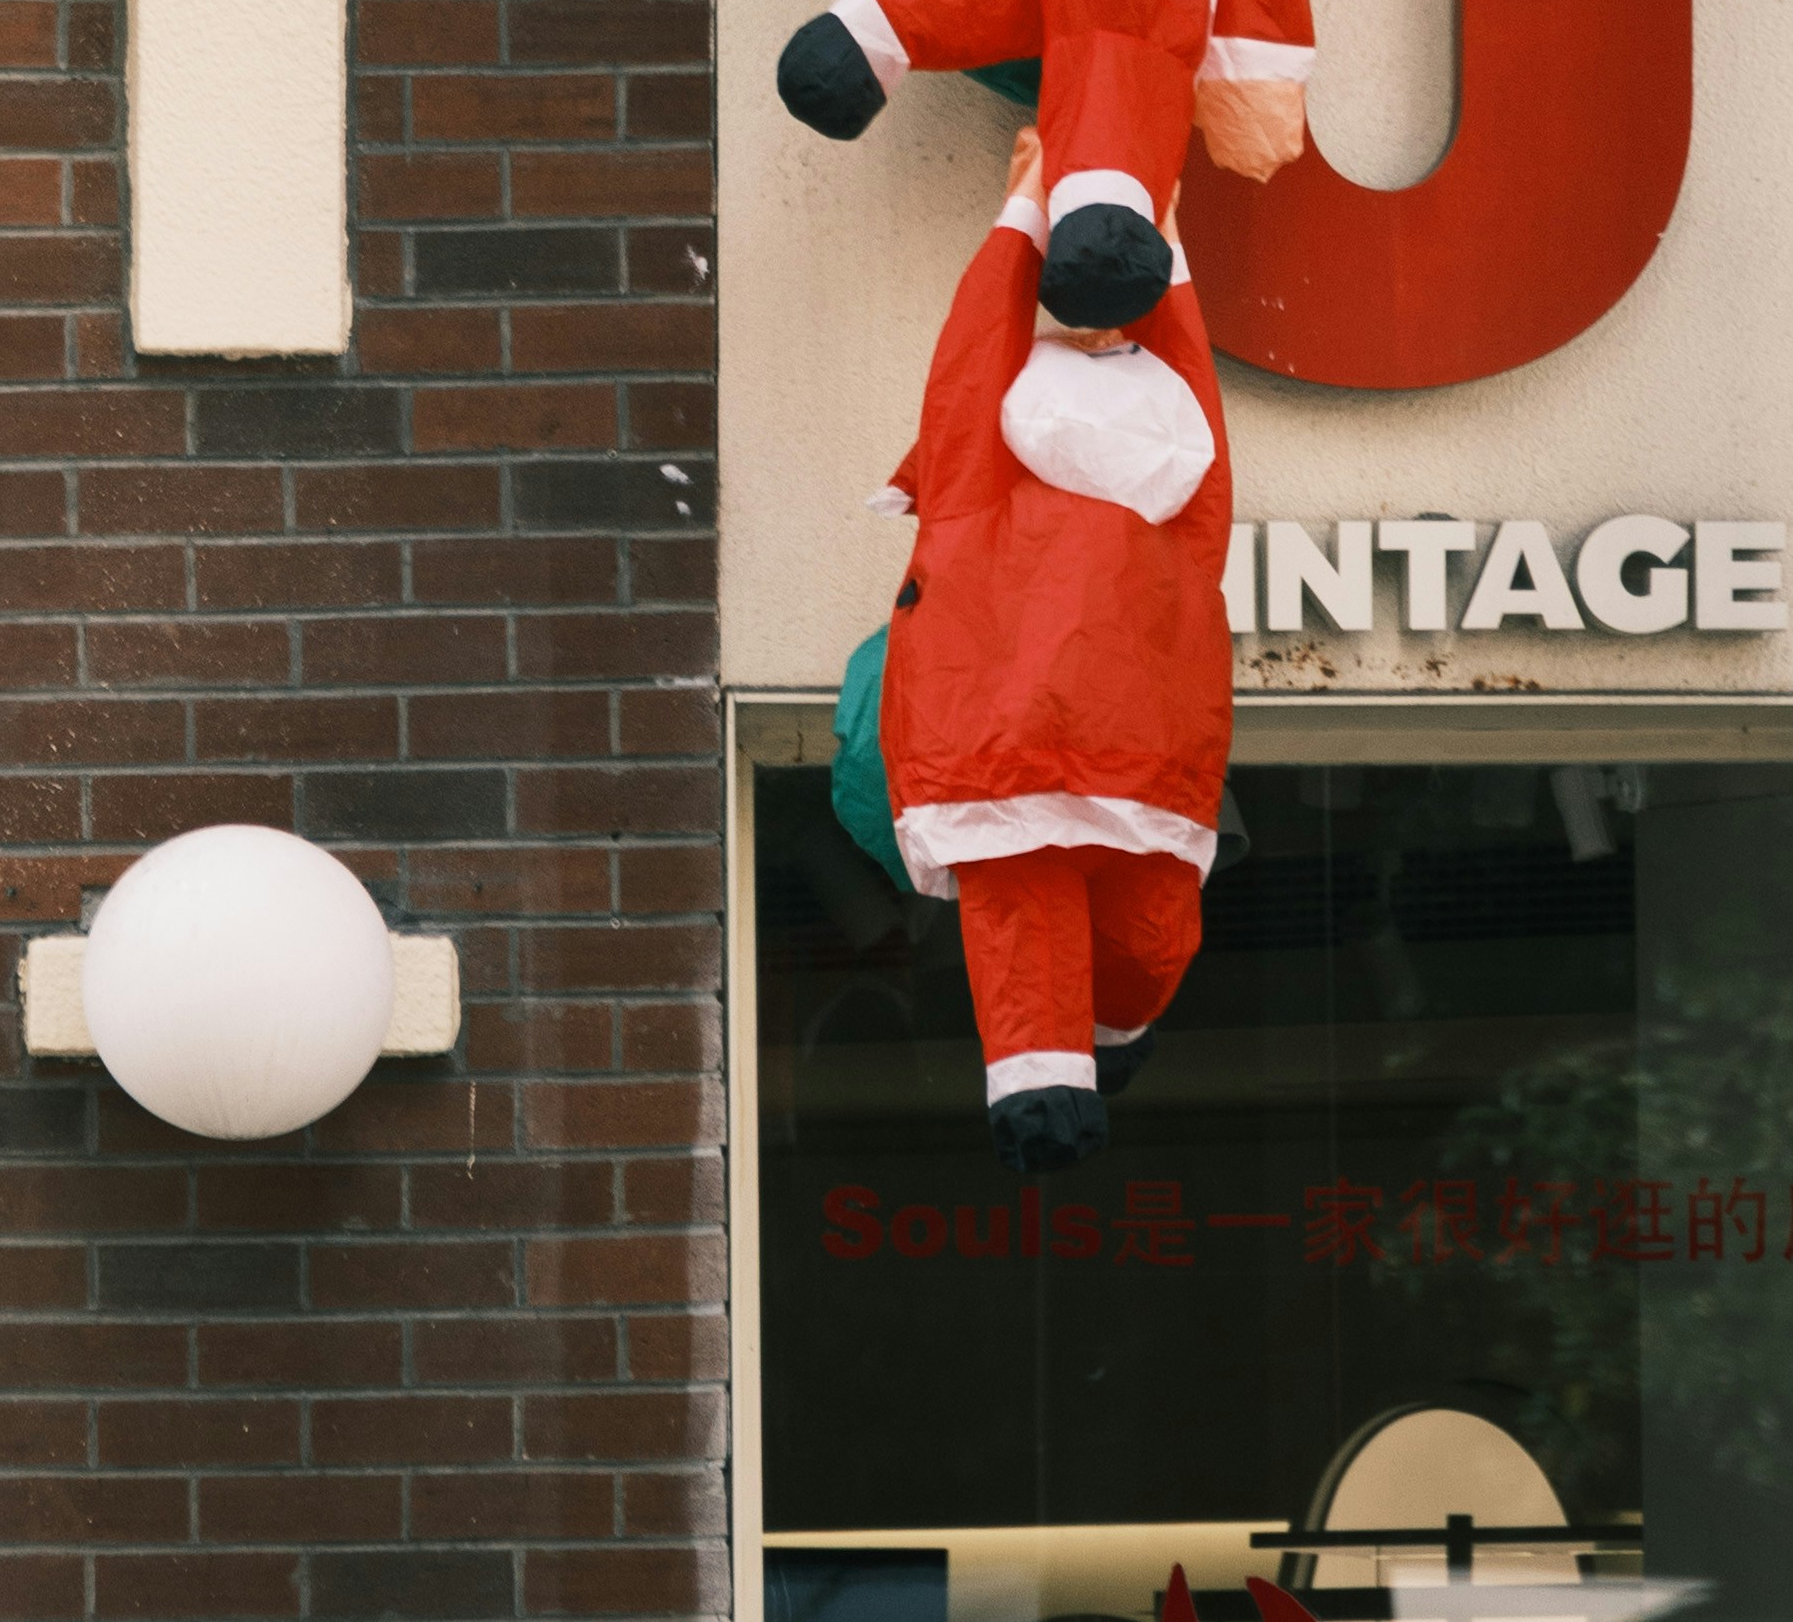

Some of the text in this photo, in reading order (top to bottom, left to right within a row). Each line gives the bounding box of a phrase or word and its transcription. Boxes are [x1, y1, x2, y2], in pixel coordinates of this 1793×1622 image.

[1222, 513, 1786, 635] INTAGE
[821, 1176, 1793, 1267] Souls是一家很好逛的
